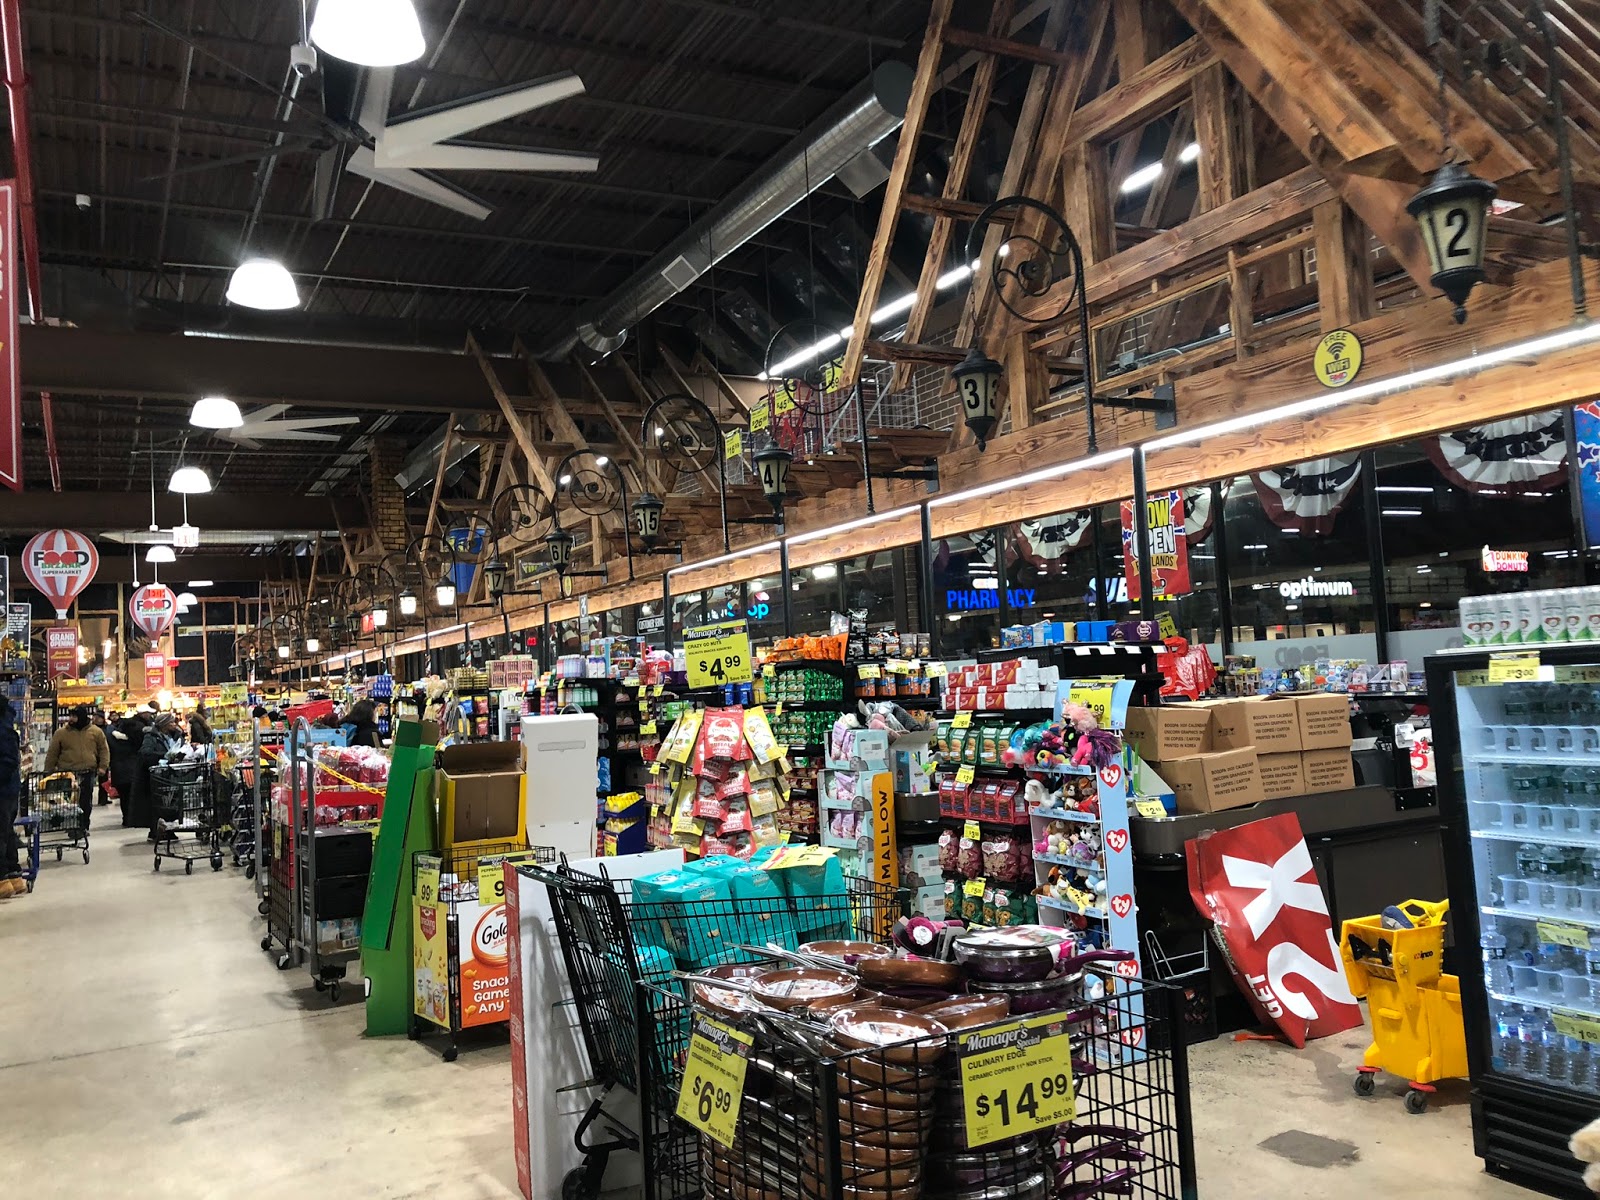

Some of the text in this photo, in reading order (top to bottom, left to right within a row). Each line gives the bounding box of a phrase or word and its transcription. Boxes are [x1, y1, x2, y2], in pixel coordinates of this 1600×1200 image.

[1446, 208, 1471, 257] 2
[1324, 333, 1348, 346] FREE
[965, 379, 979, 409] 3
[764, 464, 773, 488] 4
[649, 512, 658, 530] 5
[33, 551, 90, 566] FOOD
[552, 545, 559, 561] 6
[1496, 551, 1528, 560] DUNKIN'
[1496, 562, 1527, 571] DONUTS
[494, 573, 500, 587] 7
[137, 600, 171, 609] FOOD
[947, 588, 1035, 609] PHARMACY
[688, 626, 722, 638] Manager's
[1101, 767, 1119, 784] ty
[1107, 831, 1126, 848] ty
[1112, 896, 1130, 914] ty
[1117, 962, 1137, 979] ty
[1246, 973, 1283, 1019] GET
[478, 1001, 505, 1014] Any
[698, 1016, 729, 1043] Manager's
[719, 1042, 733, 1055] Special
[967, 1024, 1028, 1051] Manager's
[1016, 1035, 1040, 1050] Special
[1123, 1029, 1142, 1047] ty
[693, 1040, 723, 1061] CULINARY EDGE
[967, 1050, 1026, 1070] CULINARY EDGE
[968, 1070, 993, 1081] CERAMIC
[994, 1065, 1015, 1075] COPPER
[1026, 1060, 1037, 1068] NON
[1038, 1056, 1053, 1064] STICK
[1035, 1107, 1073, 1124] Save $5.00
[707, 1122, 717, 1135] Save
